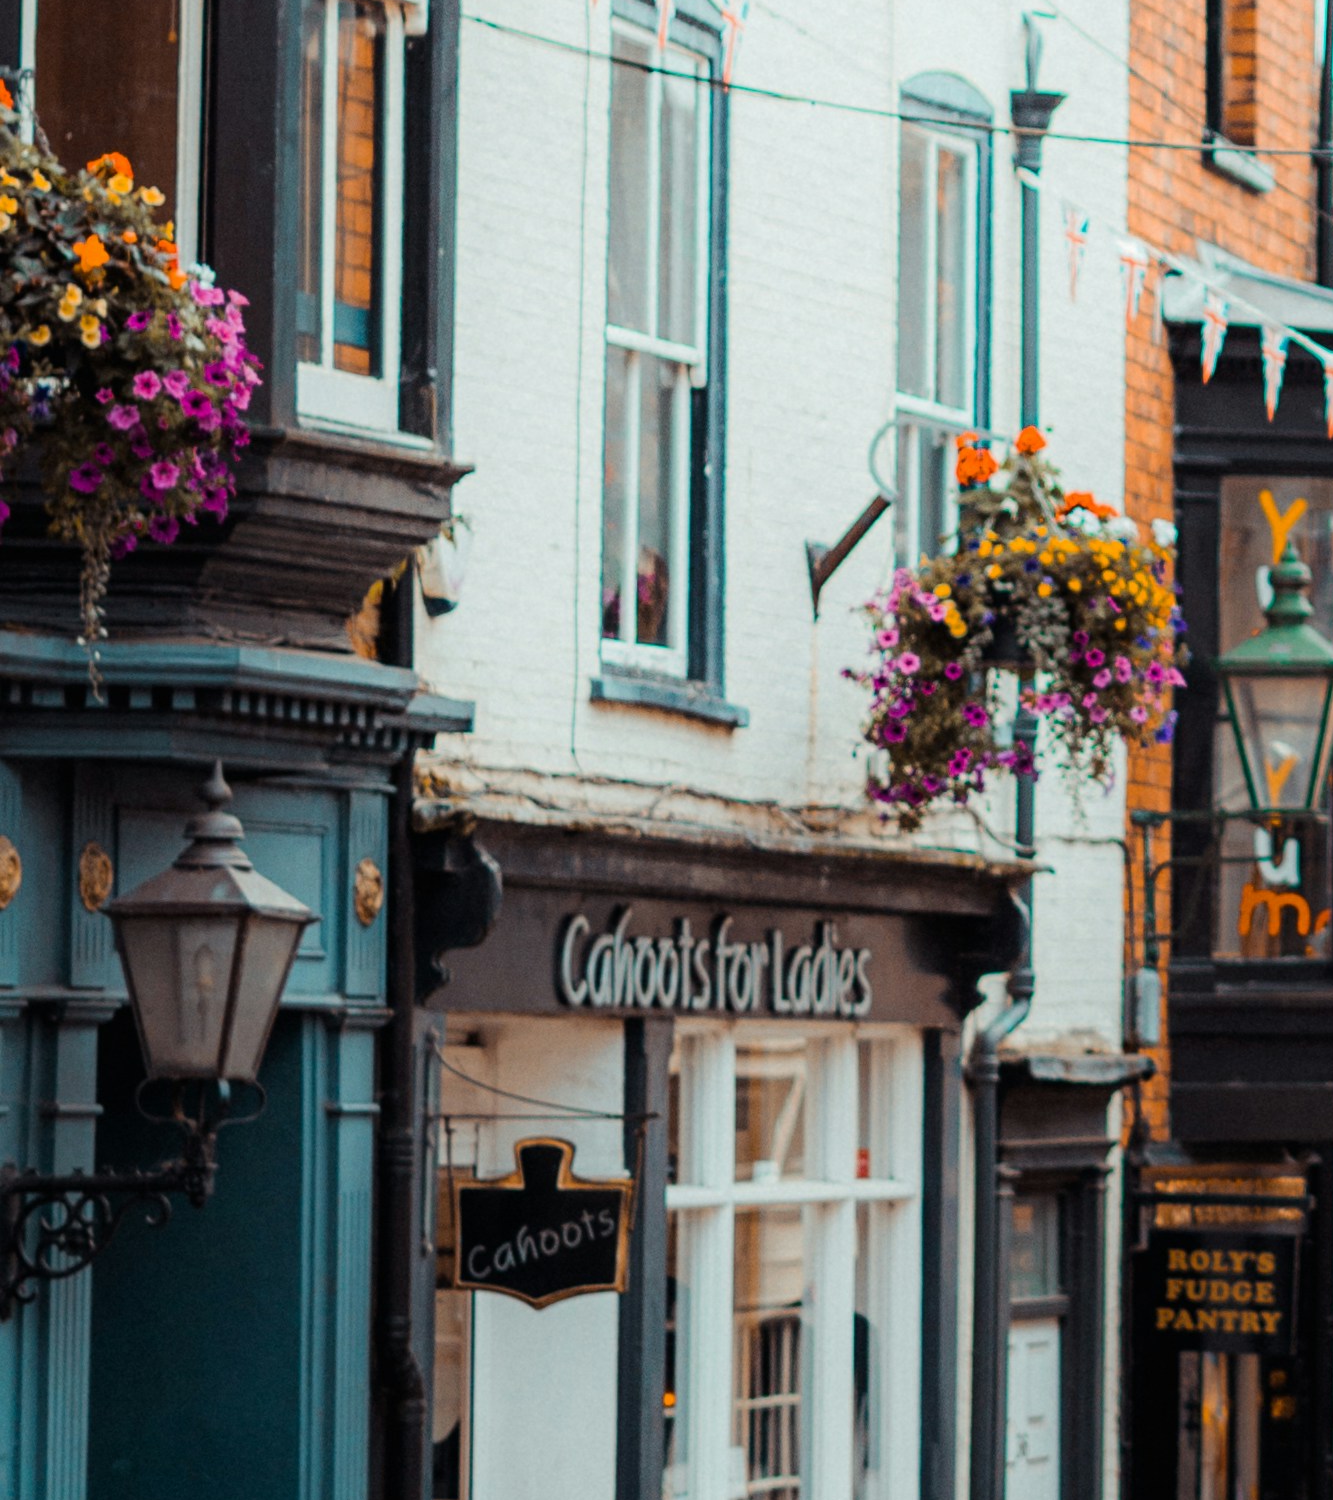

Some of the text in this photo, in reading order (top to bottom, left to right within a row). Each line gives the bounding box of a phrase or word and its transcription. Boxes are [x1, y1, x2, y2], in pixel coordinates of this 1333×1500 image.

[562, 907, 873, 1015] Cahoots for Ladies
[1167, 1248, 1277, 1275] ROLY'S
[1166, 1279, 1277, 1304] FUDGE
[1155, 1308, 1282, 1334] PANTRY
